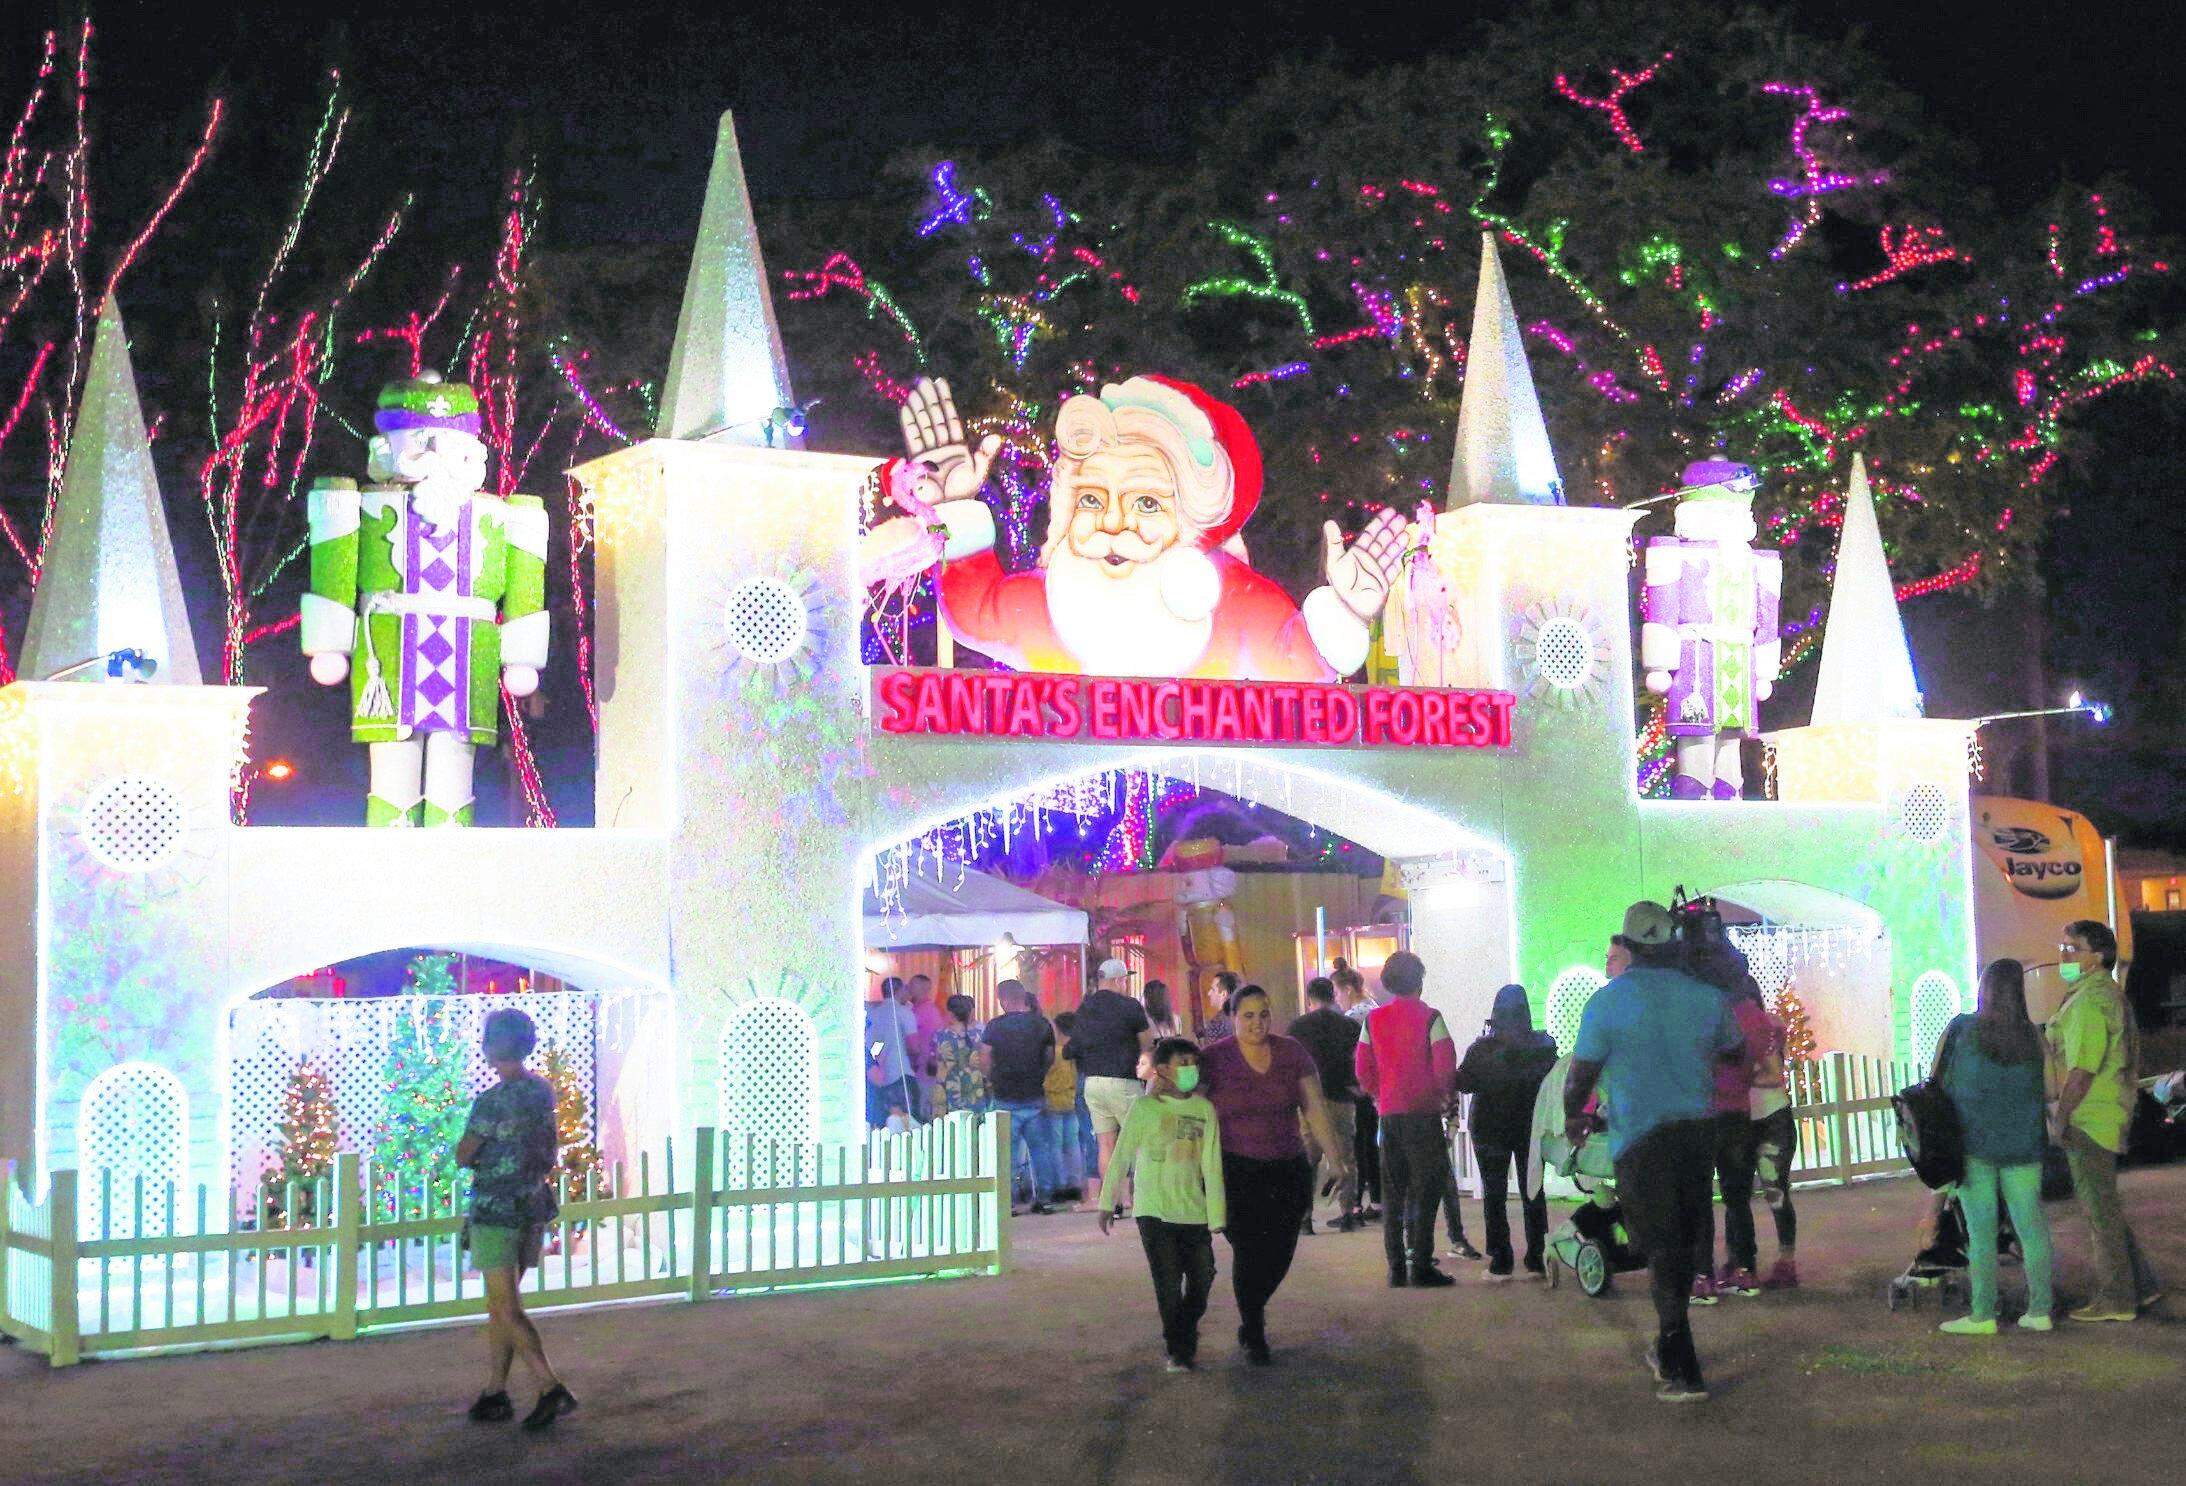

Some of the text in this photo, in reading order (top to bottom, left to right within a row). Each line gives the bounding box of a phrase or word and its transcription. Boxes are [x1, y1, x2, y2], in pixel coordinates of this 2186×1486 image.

[880, 672, 1517, 748] SANTA'S ENCHANTED FOREST
[2005, 857, 2082, 880] Jayco
